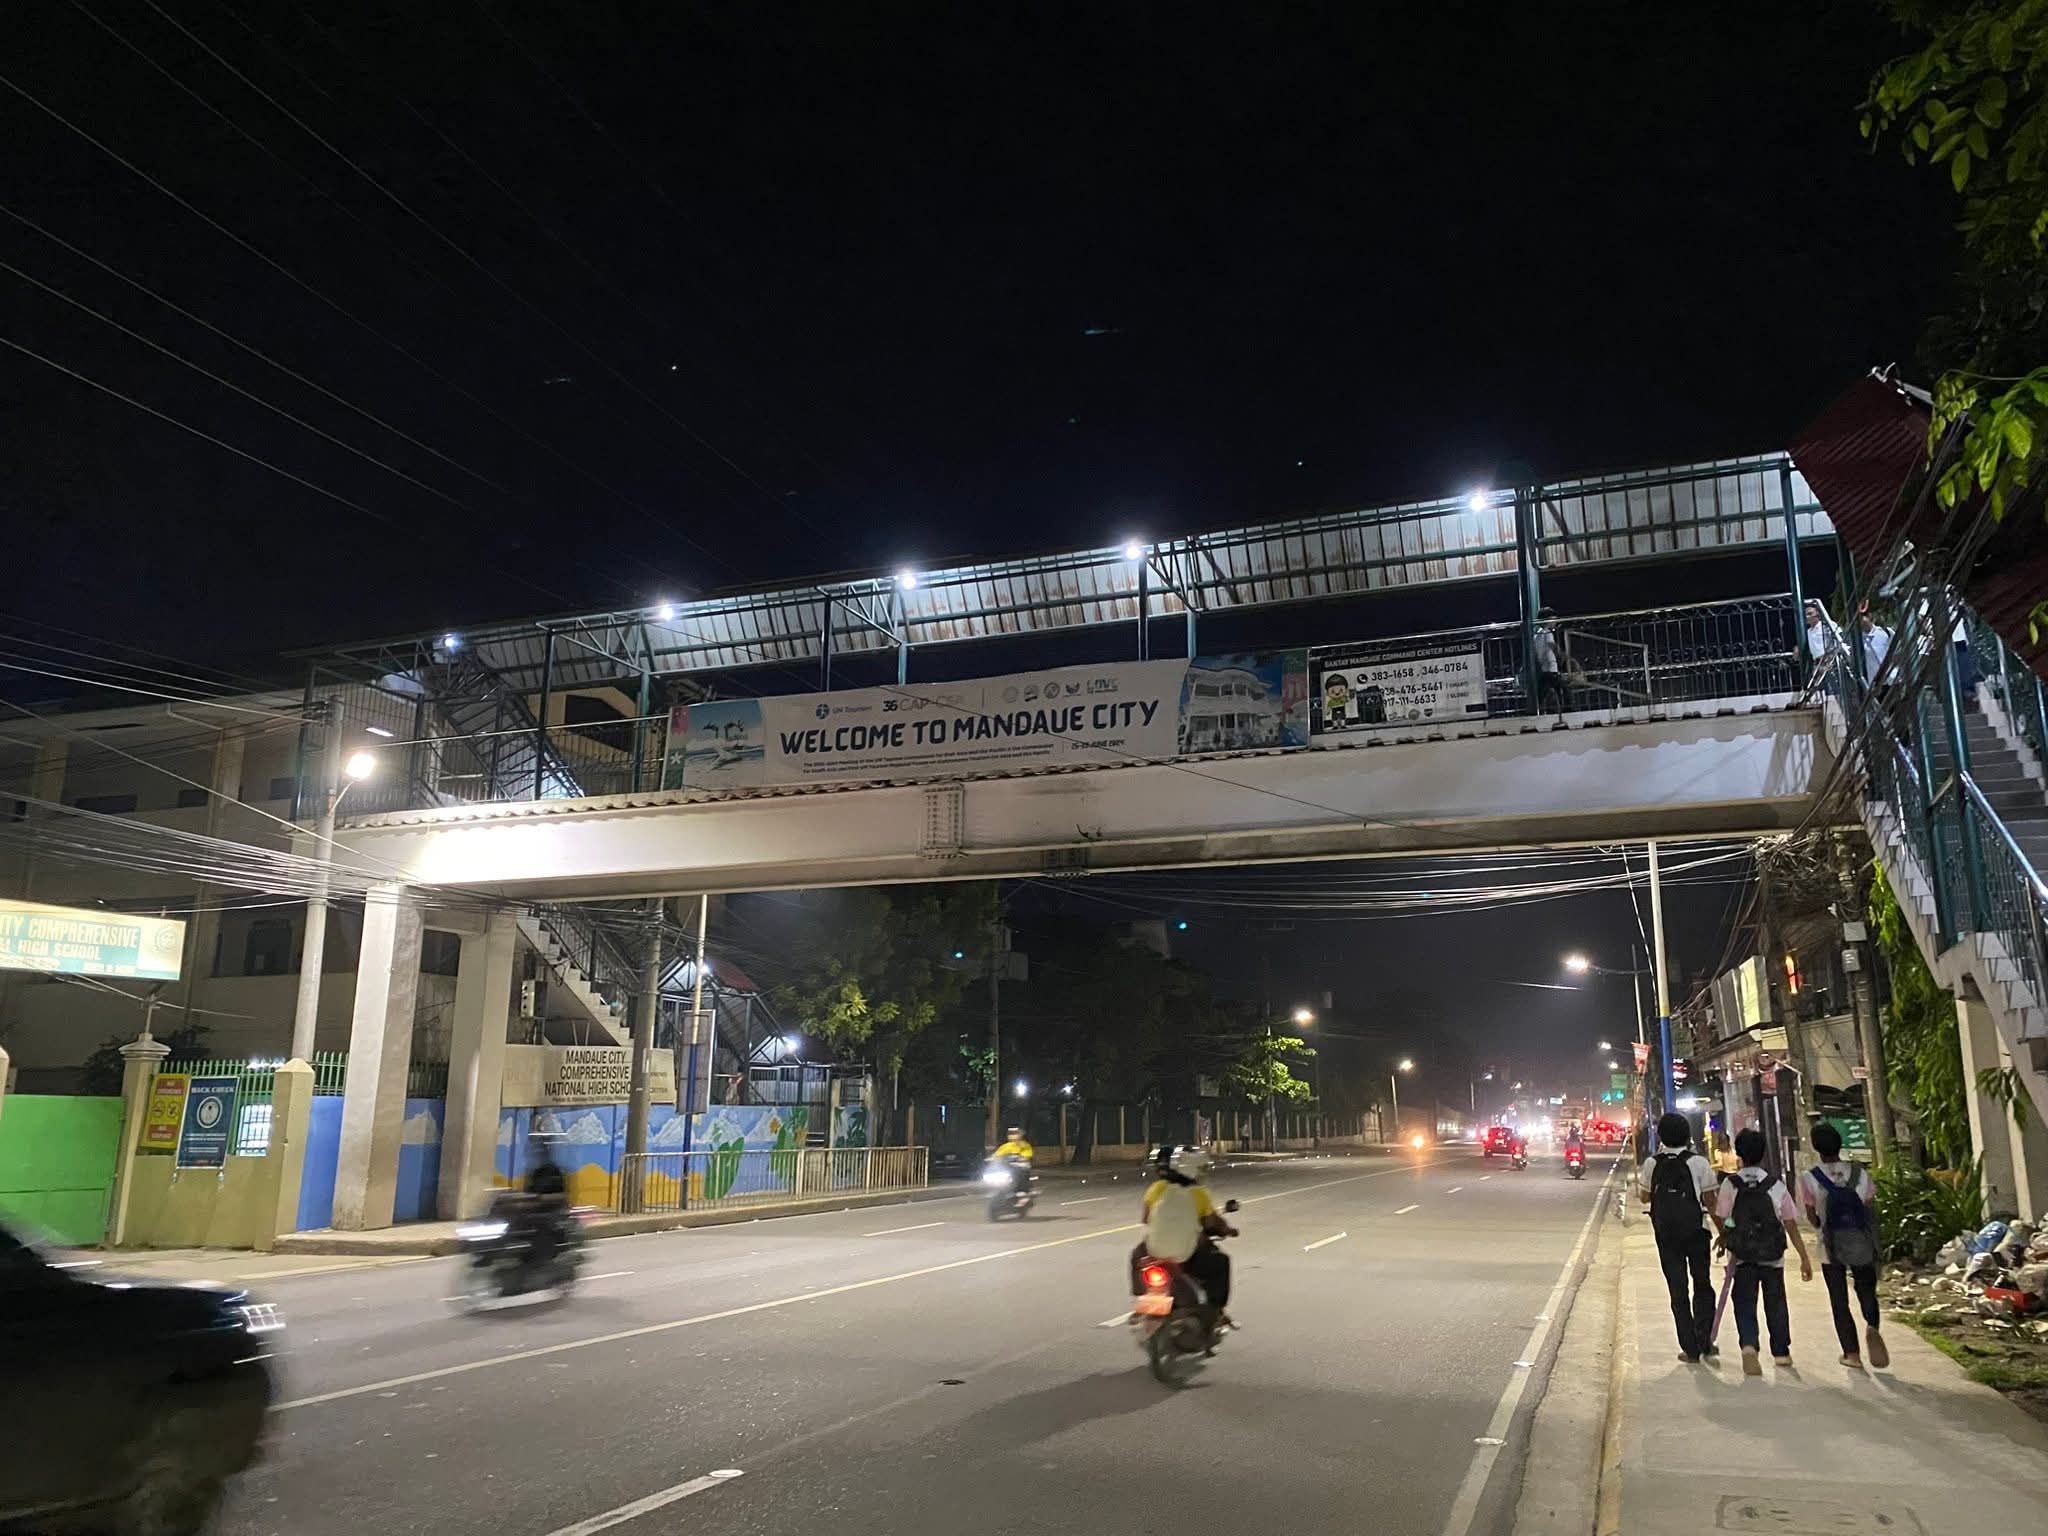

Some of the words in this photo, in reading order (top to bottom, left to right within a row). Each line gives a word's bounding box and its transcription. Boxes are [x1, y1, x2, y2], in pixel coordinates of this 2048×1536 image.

[781, 722, 905, 755] WELCOME
[912, 719, 946, 745] TO
[953, 706, 1085, 742] MANDAUE
[1093, 700, 1159, 730] CITY
[29, 918, 139, 947] COMPREHENSIVE
[17, 939, 48, 957] HIGH
[54, 943, 100, 961] SCHOOL
[565, 1050, 608, 1064] MANDAUE
[608, 1050, 627, 1064] CITY
[559, 1065, 630, 1081] COMPREHENSIVE
[544, 1081, 587, 1097] NATIONAL
[588, 1081, 608, 1096] HIGH
[609, 1081, 632, 1095] SCHO
